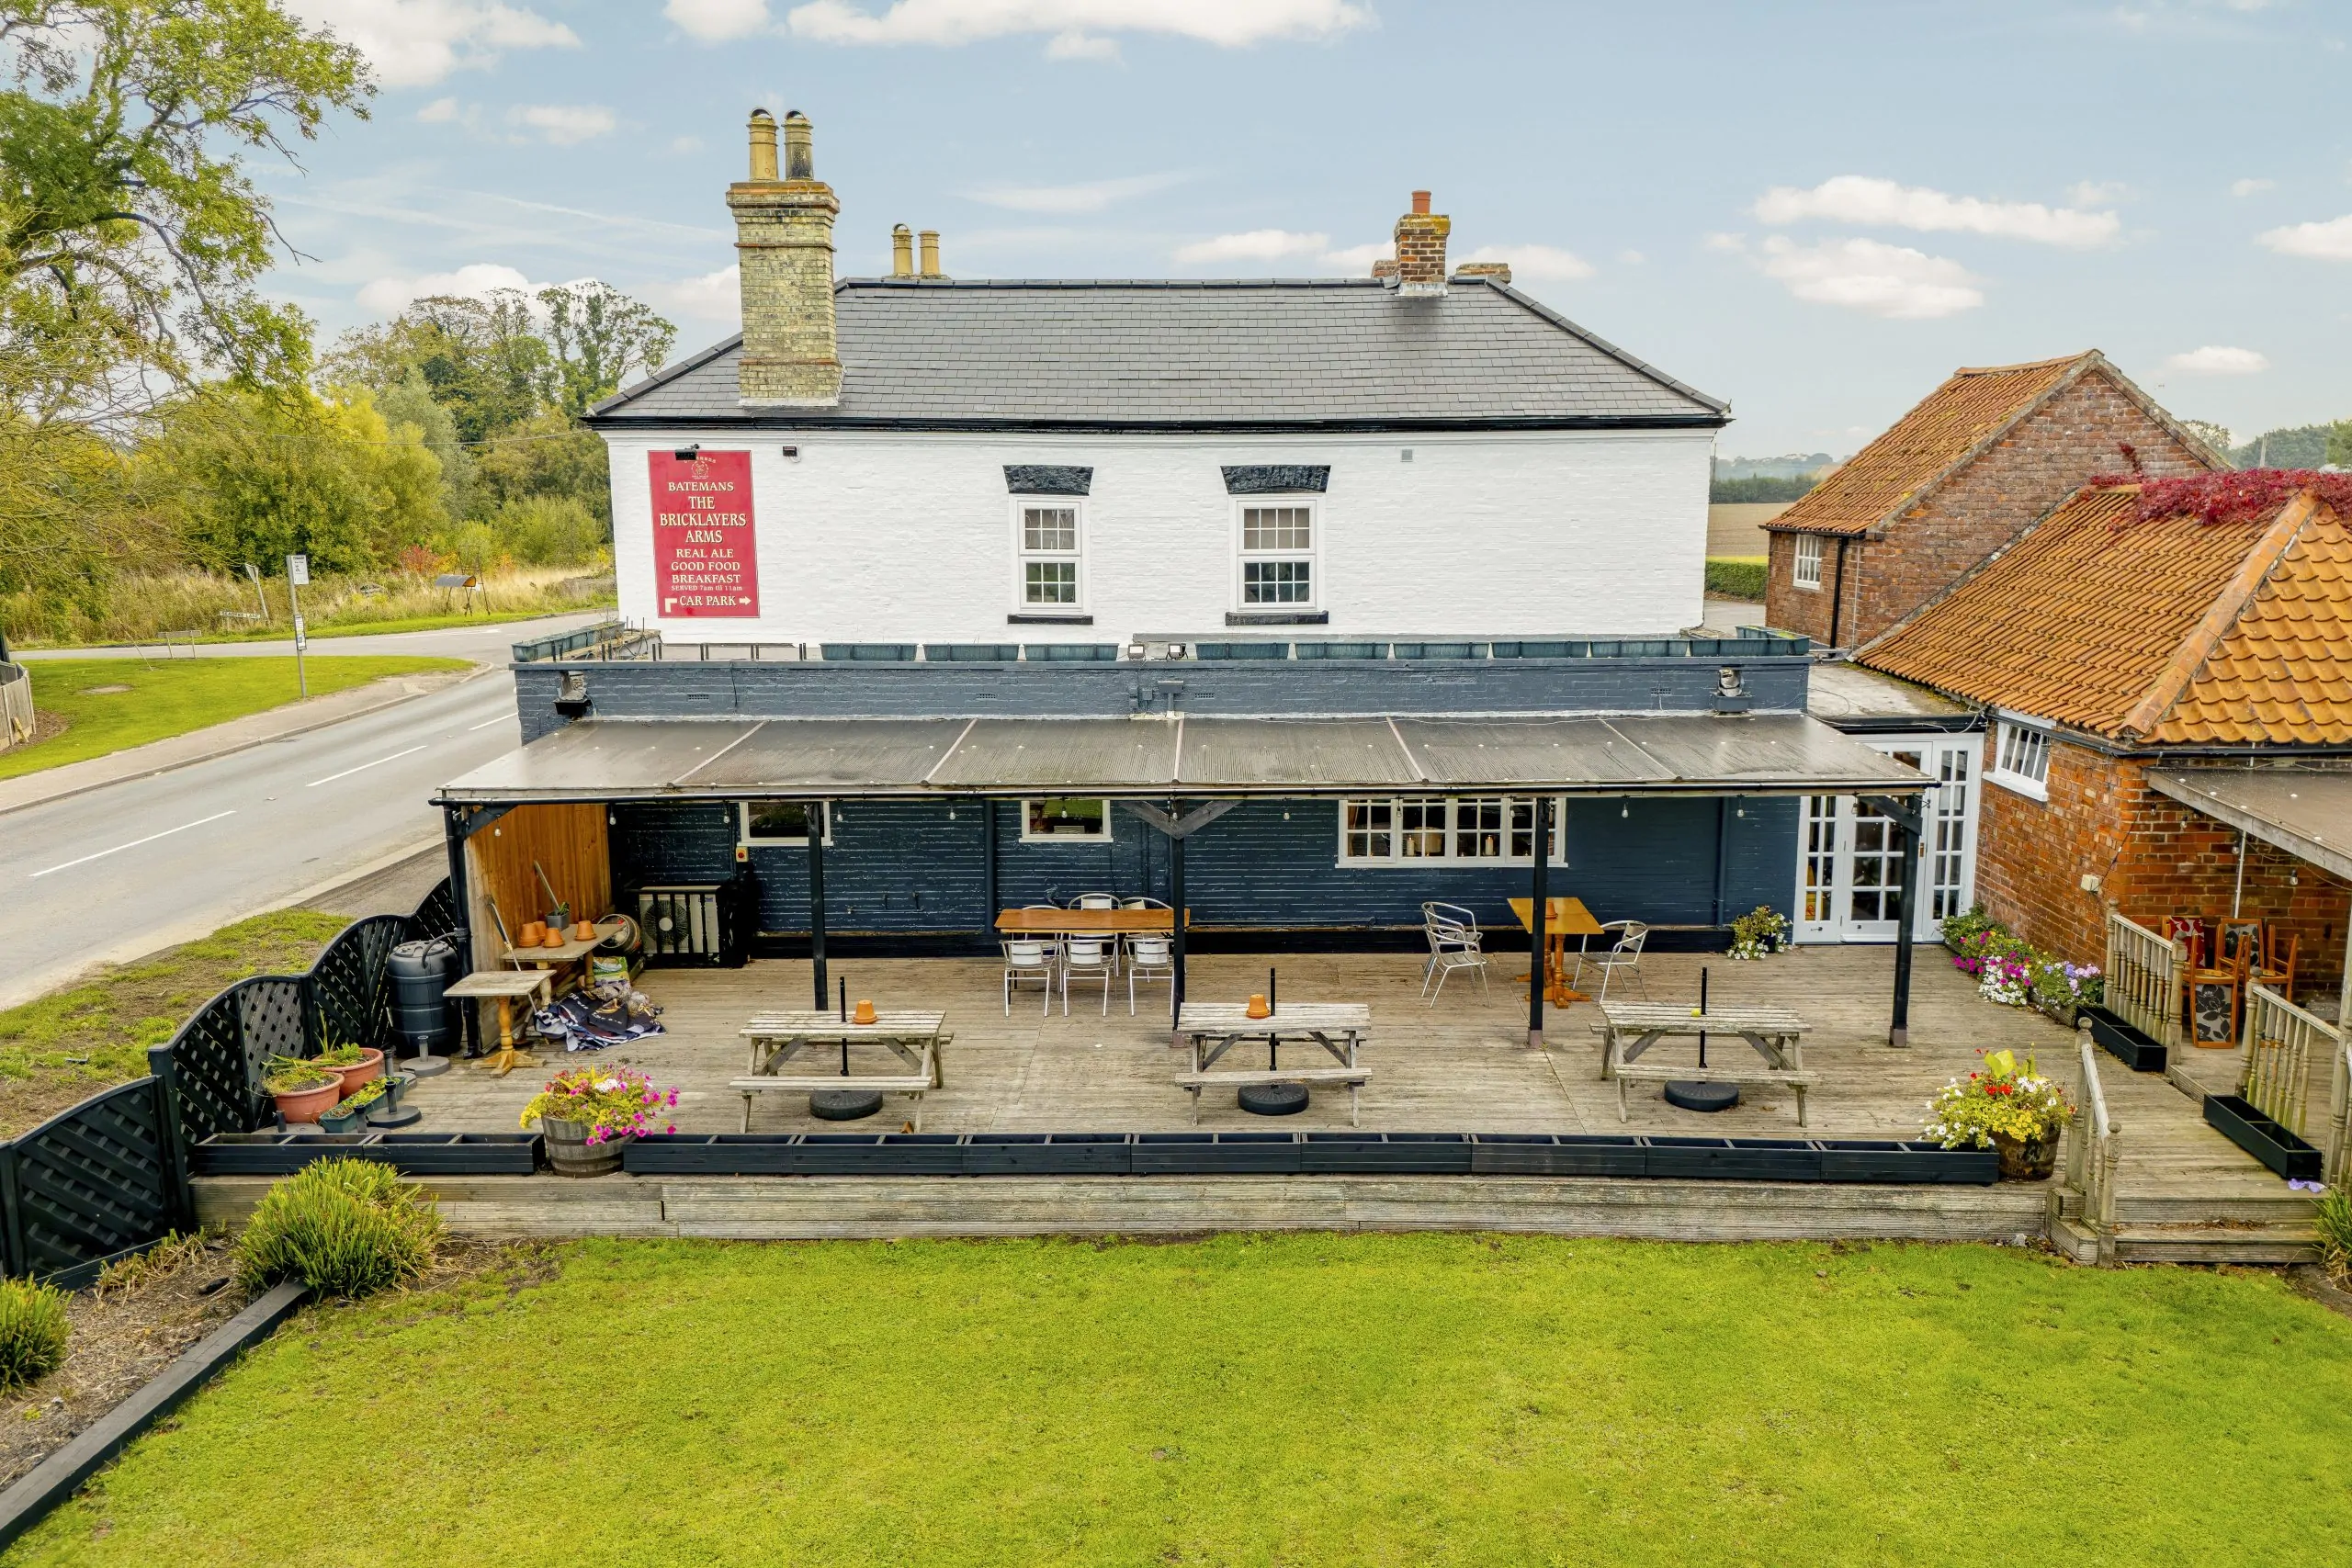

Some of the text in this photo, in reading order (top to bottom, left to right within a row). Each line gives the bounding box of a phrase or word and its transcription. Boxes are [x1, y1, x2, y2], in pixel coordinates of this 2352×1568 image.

[668, 481, 734, 491] BATEMANS
[688, 496, 716, 510] THE
[660, 513, 746, 526] BRICKLAYERS
[685, 530, 723, 544] ARMS
[676, 548, 734, 558] REAL ALE
[671, 561, 741, 571] GOOD FOOD
[672, 574, 741, 584] BREAKFAST
[680, 595, 737, 606] CAR PARK
